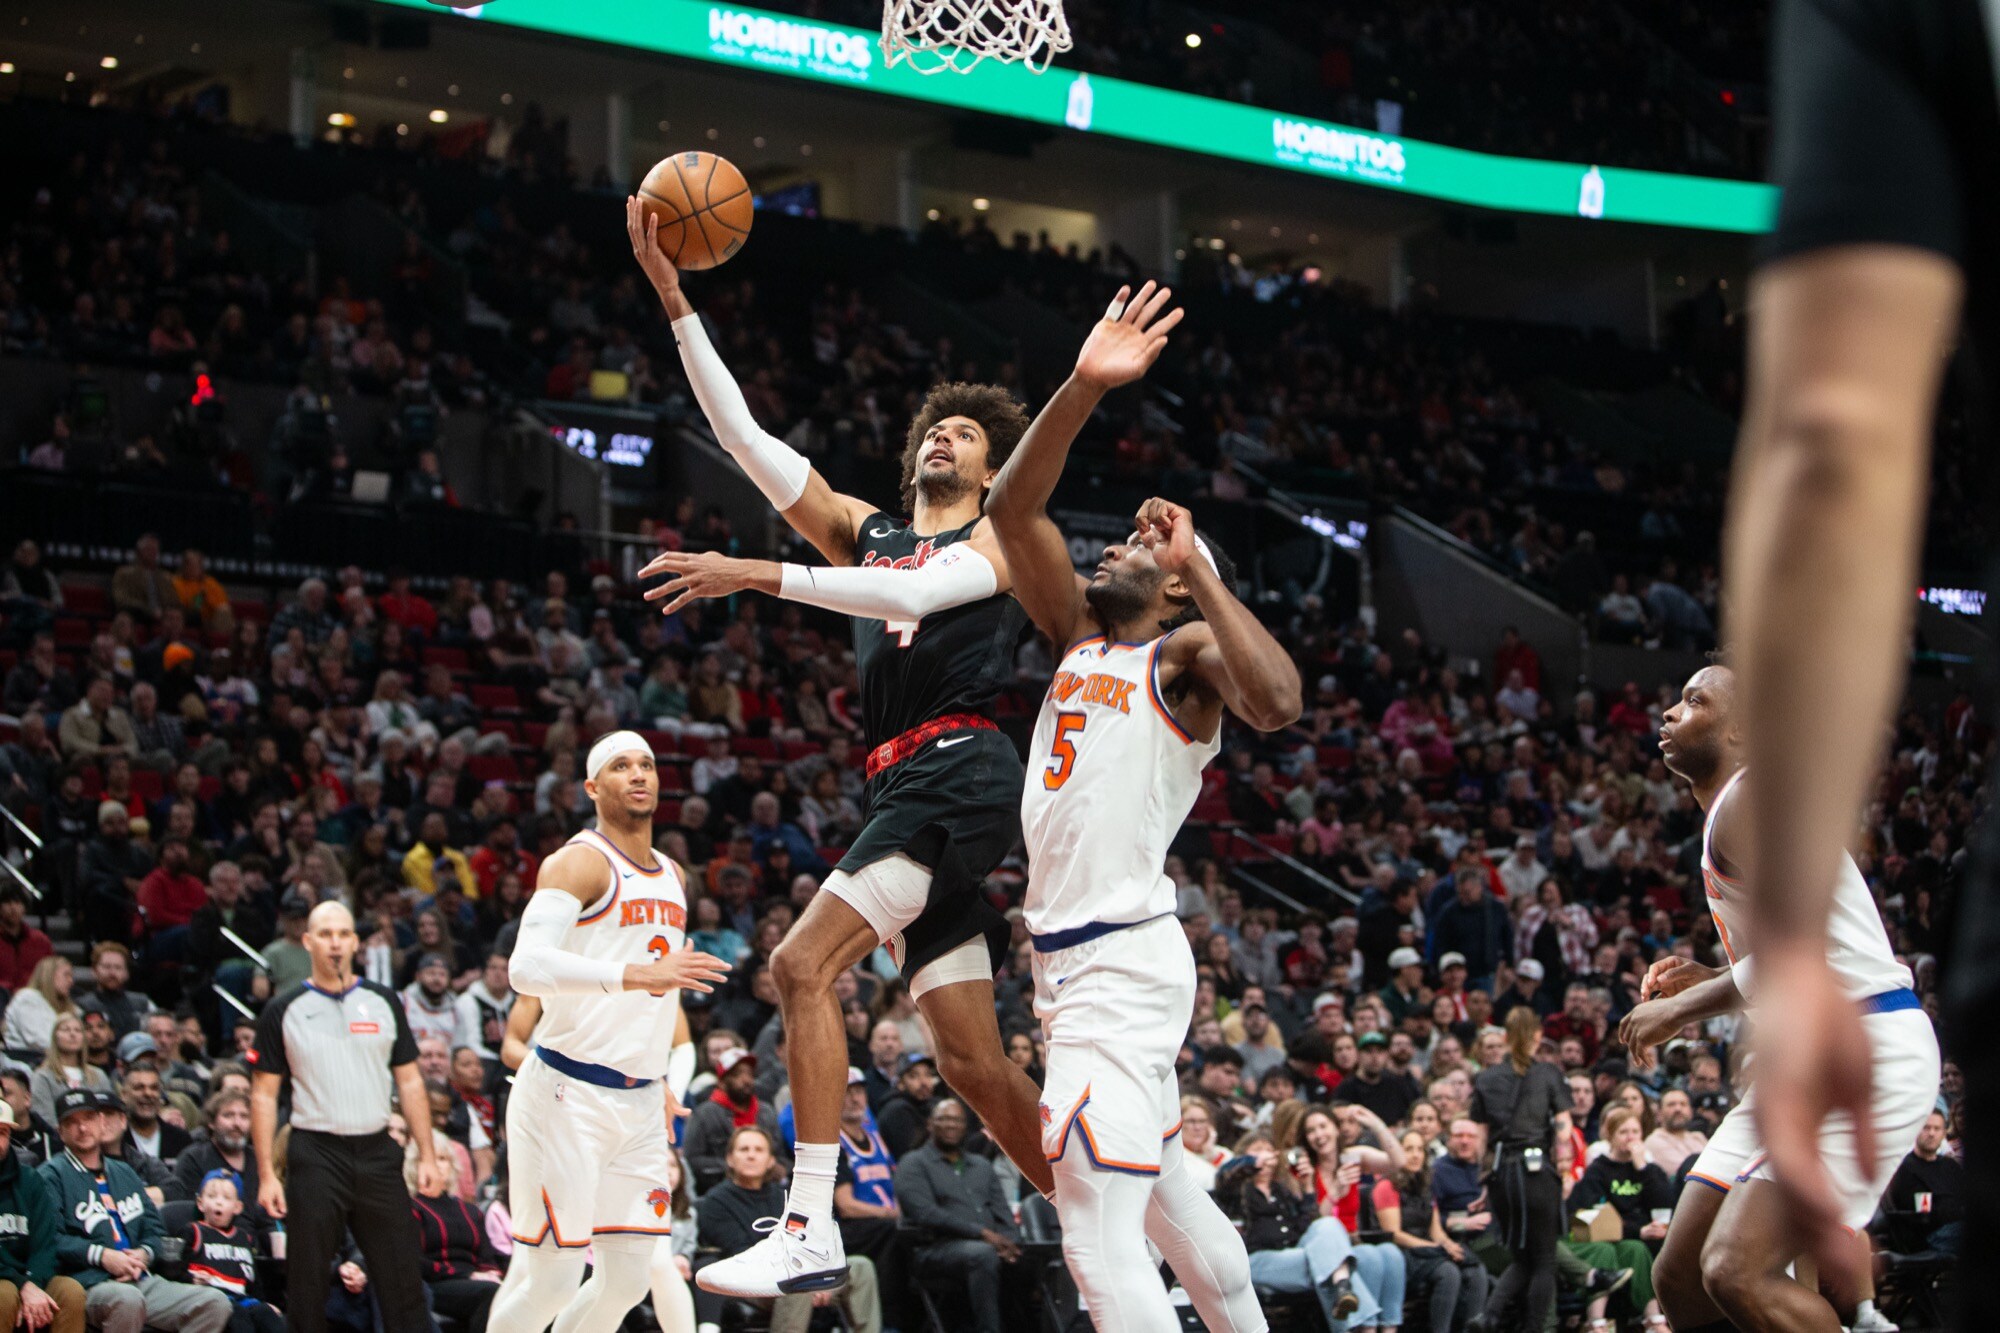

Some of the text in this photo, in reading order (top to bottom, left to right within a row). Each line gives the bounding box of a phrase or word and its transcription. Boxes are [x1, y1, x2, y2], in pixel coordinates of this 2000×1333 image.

[709, 8, 872, 68] HORNITOS
[1273, 118, 1405, 173] HORNITOS
[1043, 712, 1087, 791] 5
[619, 898, 655, 927] NEW
